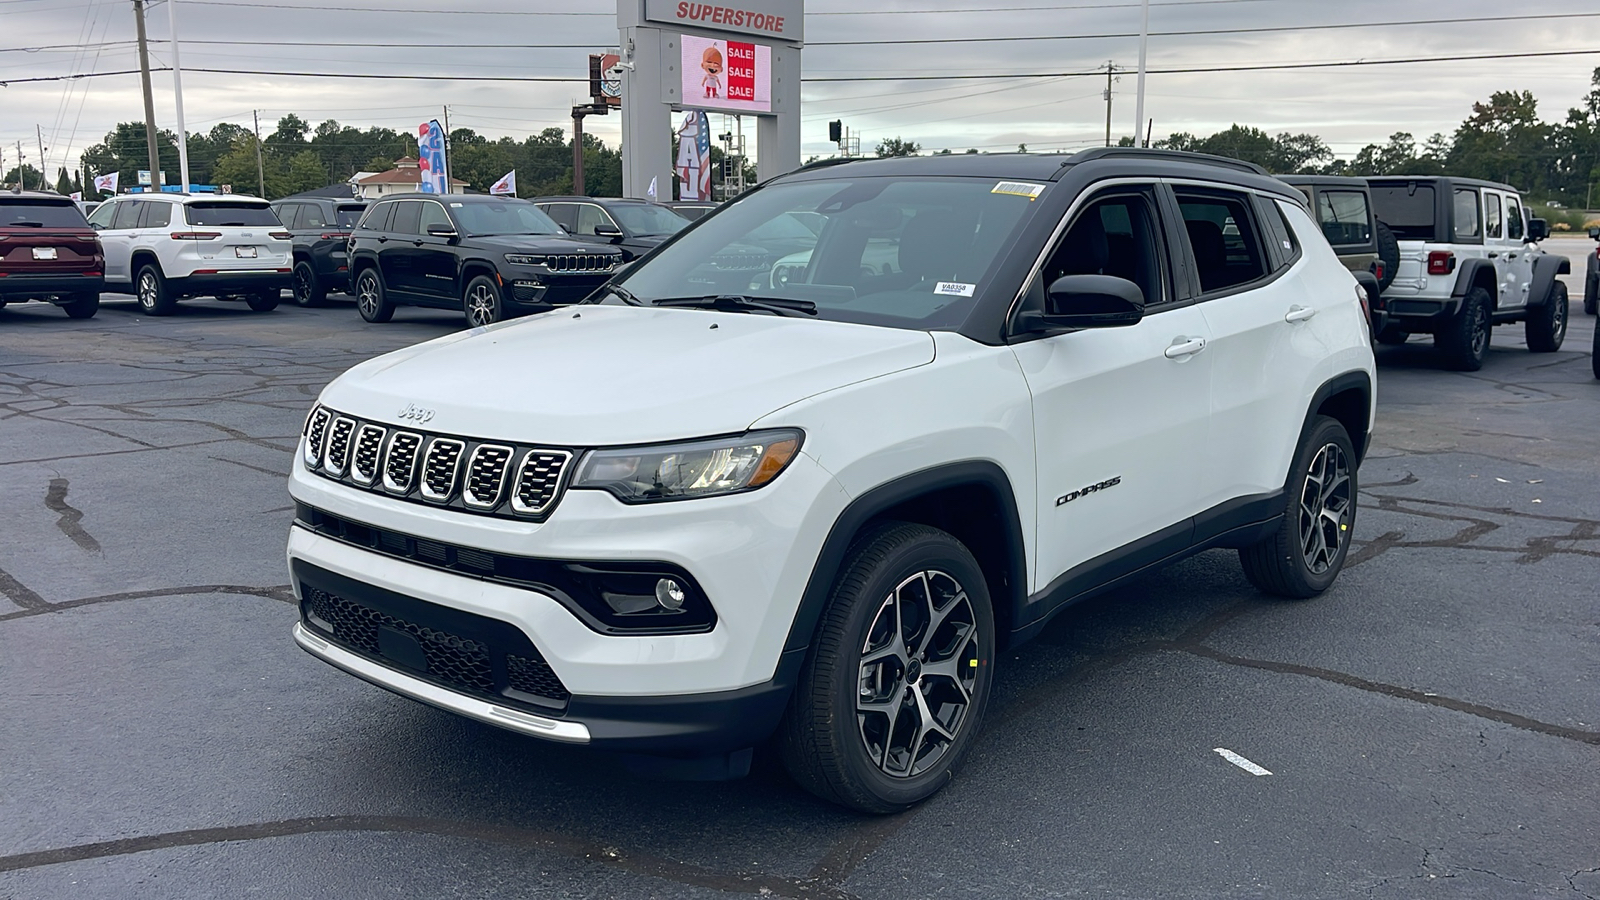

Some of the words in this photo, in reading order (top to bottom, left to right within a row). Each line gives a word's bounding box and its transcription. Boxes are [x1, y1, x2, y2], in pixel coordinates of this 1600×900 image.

[676, 1, 785, 32] SUPERSTORE
[728, 47, 753, 59] SALE!
[728, 67, 753, 78] SALE!
[729, 86, 753, 97] SALE!
[397, 402, 436, 425] Jeep
[1055, 475, 1122, 507] COMPASS
